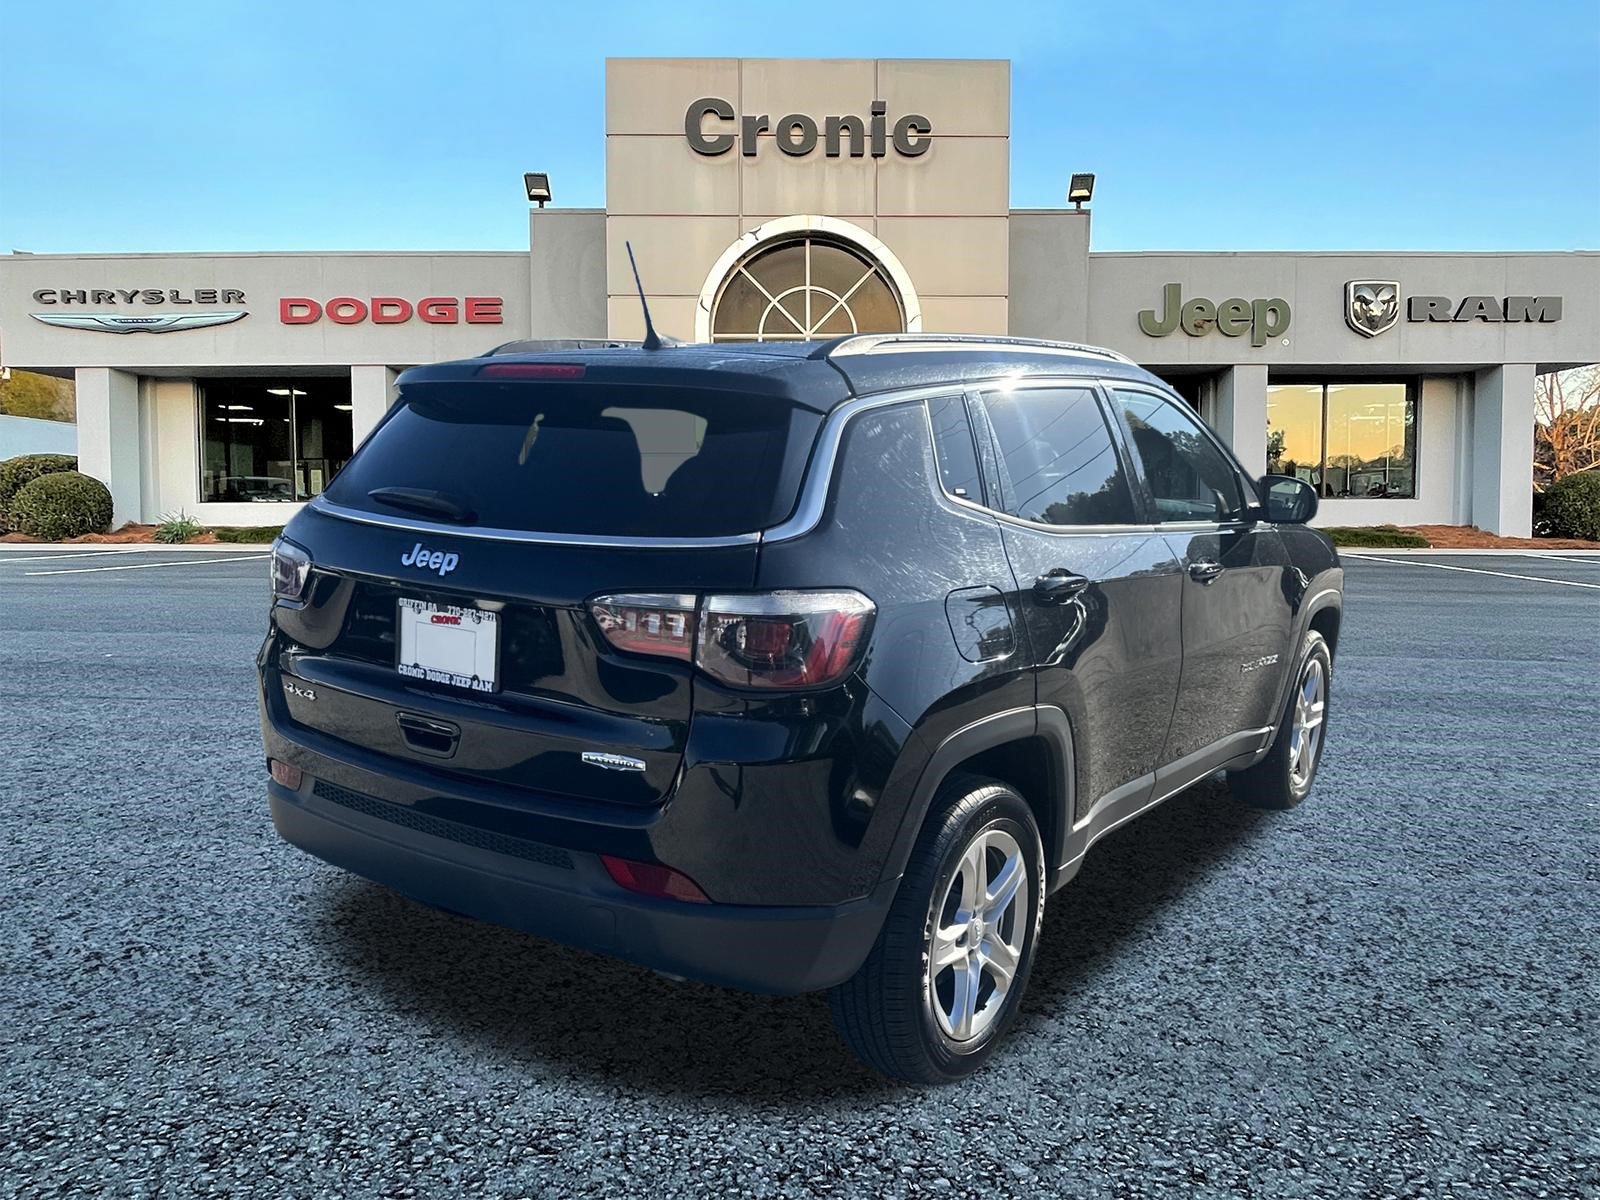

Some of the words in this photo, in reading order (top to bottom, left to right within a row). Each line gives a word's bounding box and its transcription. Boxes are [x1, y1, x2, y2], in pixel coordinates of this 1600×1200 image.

[684, 97, 932, 157] Cronic
[32, 288, 247, 306] CHRYSLER
[279, 296, 504, 325] DODGE
[1407, 296, 1564, 323] RAM
[1138, 283, 1292, 347] Jeep
[401, 543, 459, 576] Jeep
[398, 664, 425, 679] CRONIC
[426, 669, 450, 684] DODGE
[451, 675, 472, 688] JEEP
[471, 679, 493, 693] RAM
